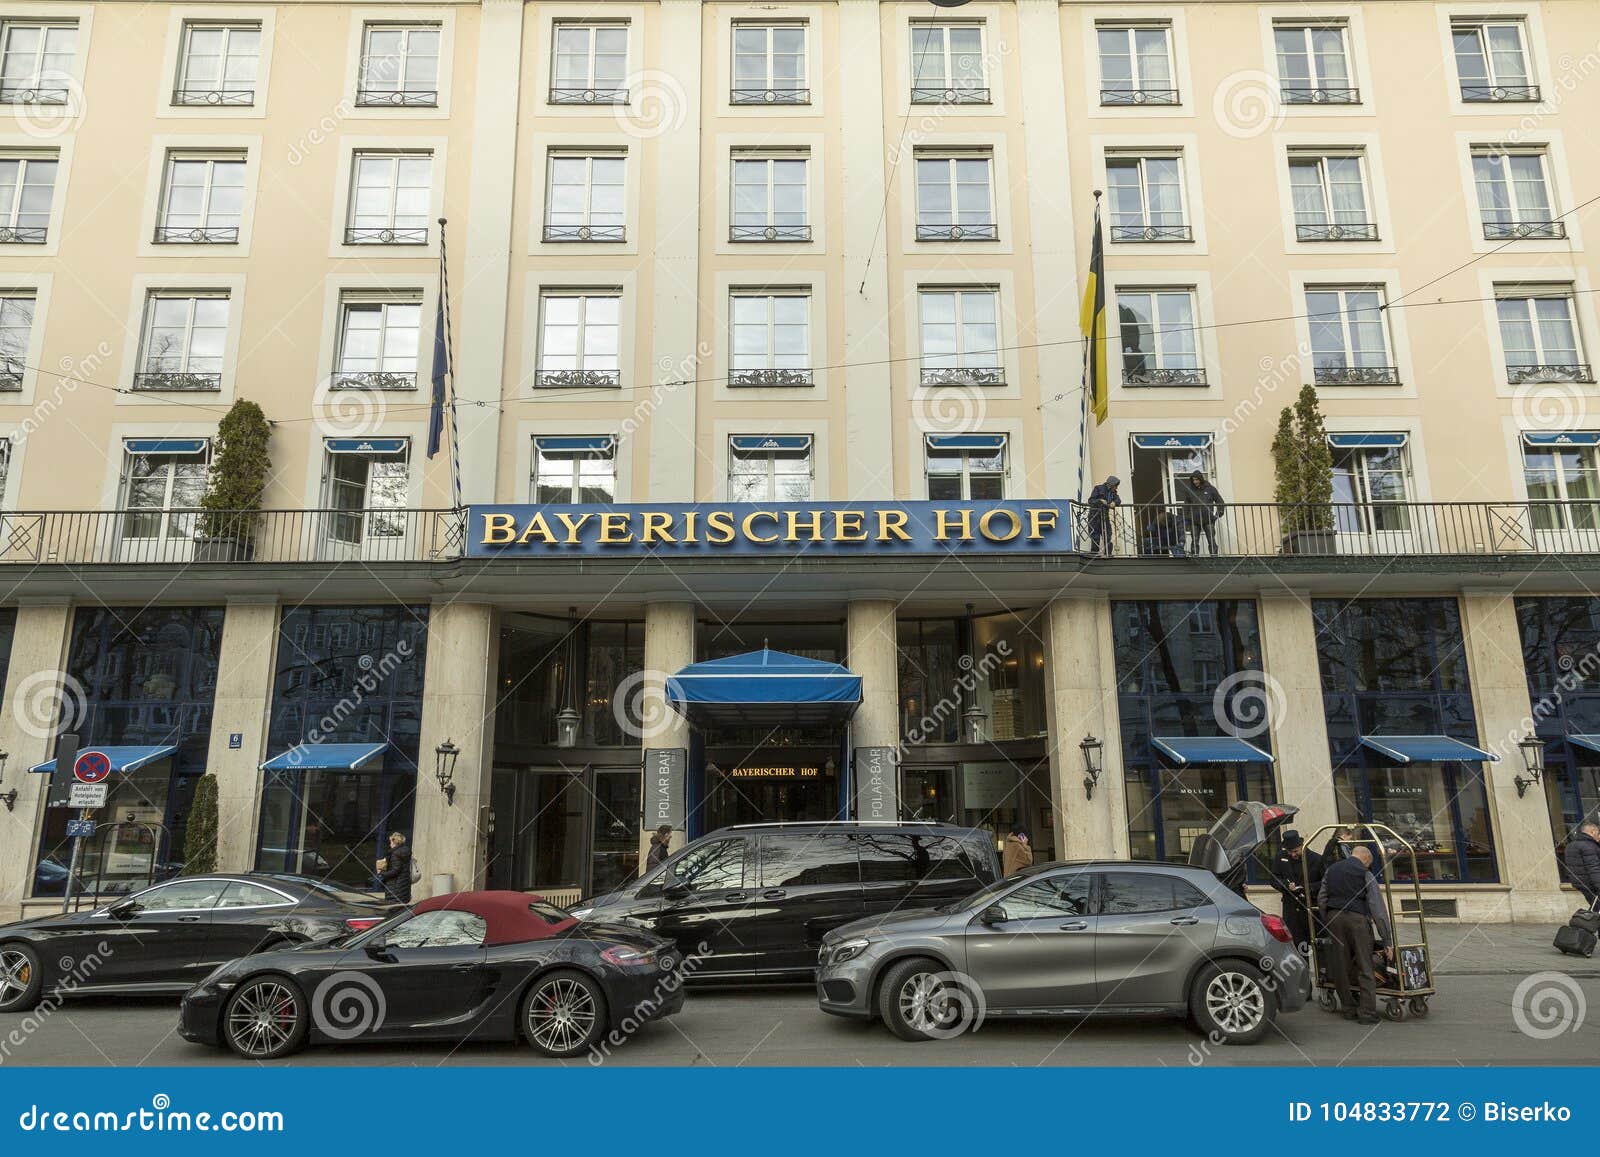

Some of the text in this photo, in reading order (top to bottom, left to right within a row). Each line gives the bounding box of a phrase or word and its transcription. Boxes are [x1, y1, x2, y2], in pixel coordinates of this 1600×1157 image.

[480, 508, 1060, 544] BAYERISCHER HOF
[659, 751, 670, 775] BAR
[732, 767, 818, 776] BAYERISCHER HOF
[658, 778, 670, 818] POLAR
[870, 749, 883, 817] POLAR BAR
